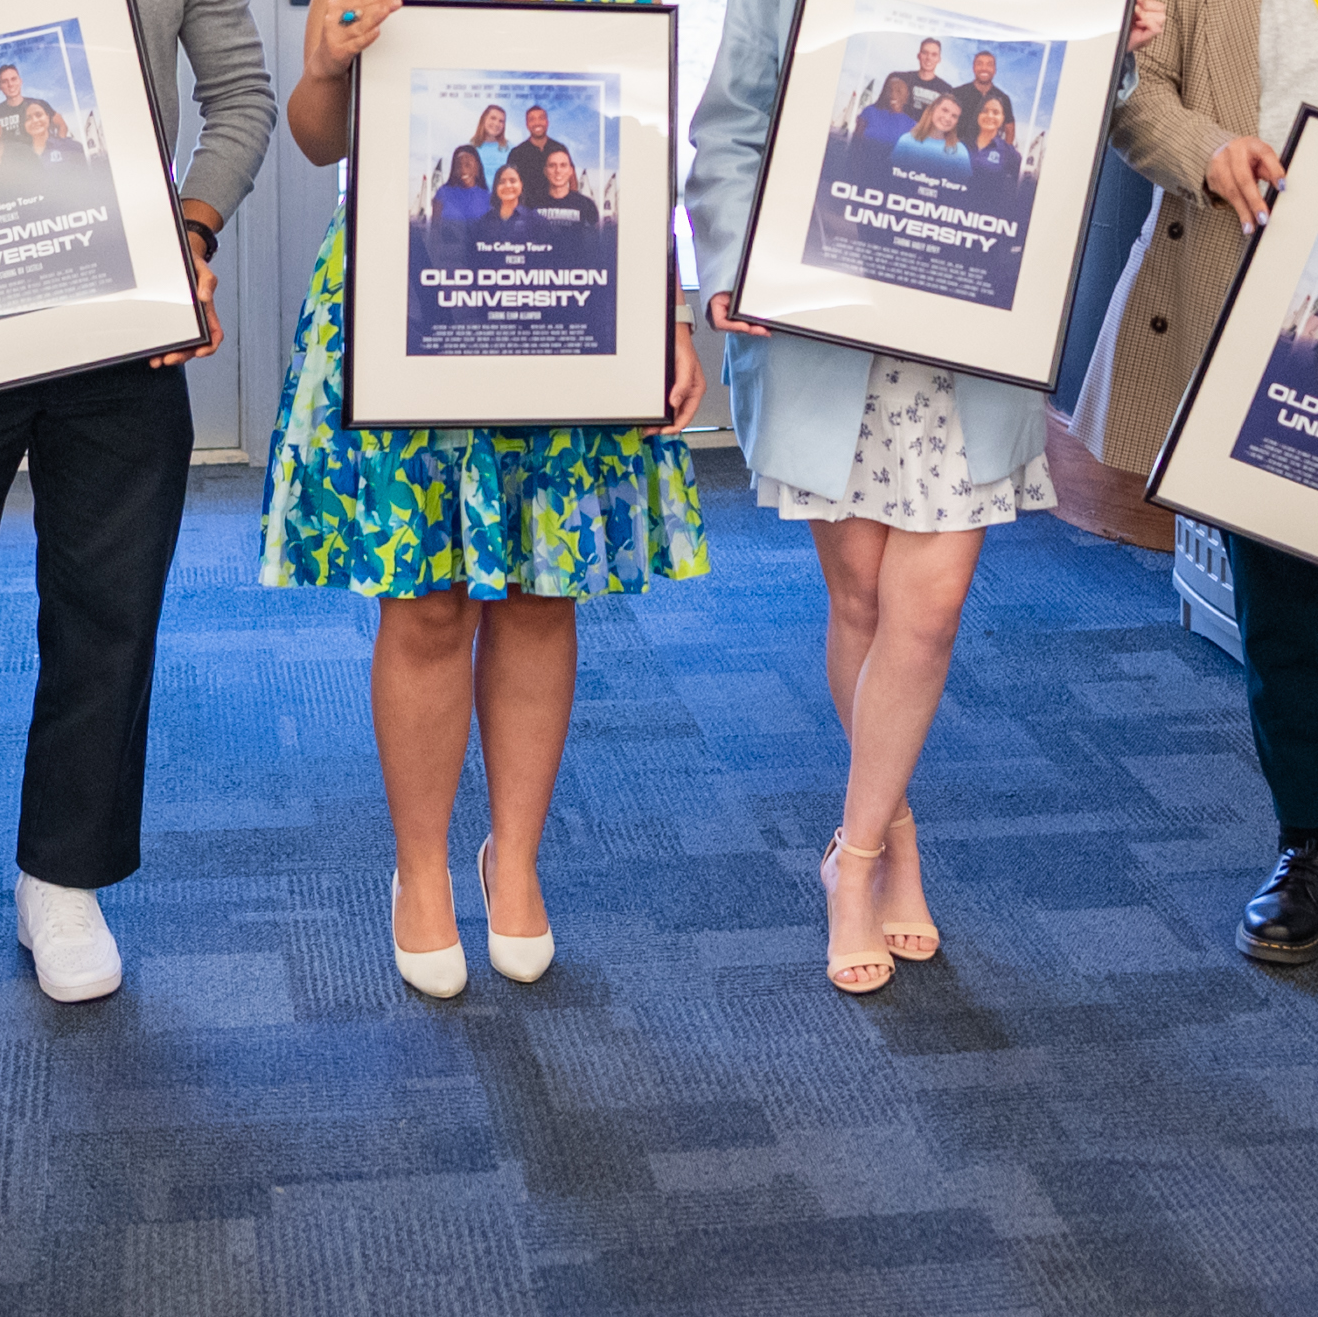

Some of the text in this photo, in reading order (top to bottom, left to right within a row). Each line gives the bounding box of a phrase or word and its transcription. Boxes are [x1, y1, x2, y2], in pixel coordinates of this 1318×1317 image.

[17, 196, 37, 206] Tour
[831, 182, 1017, 236] OLD DOMINION
[844, 205, 997, 252] UNIVERSITY
[421, 270, 607, 285] OLD DOMINION
[438, 290, 590, 306] UNIVERSITY
